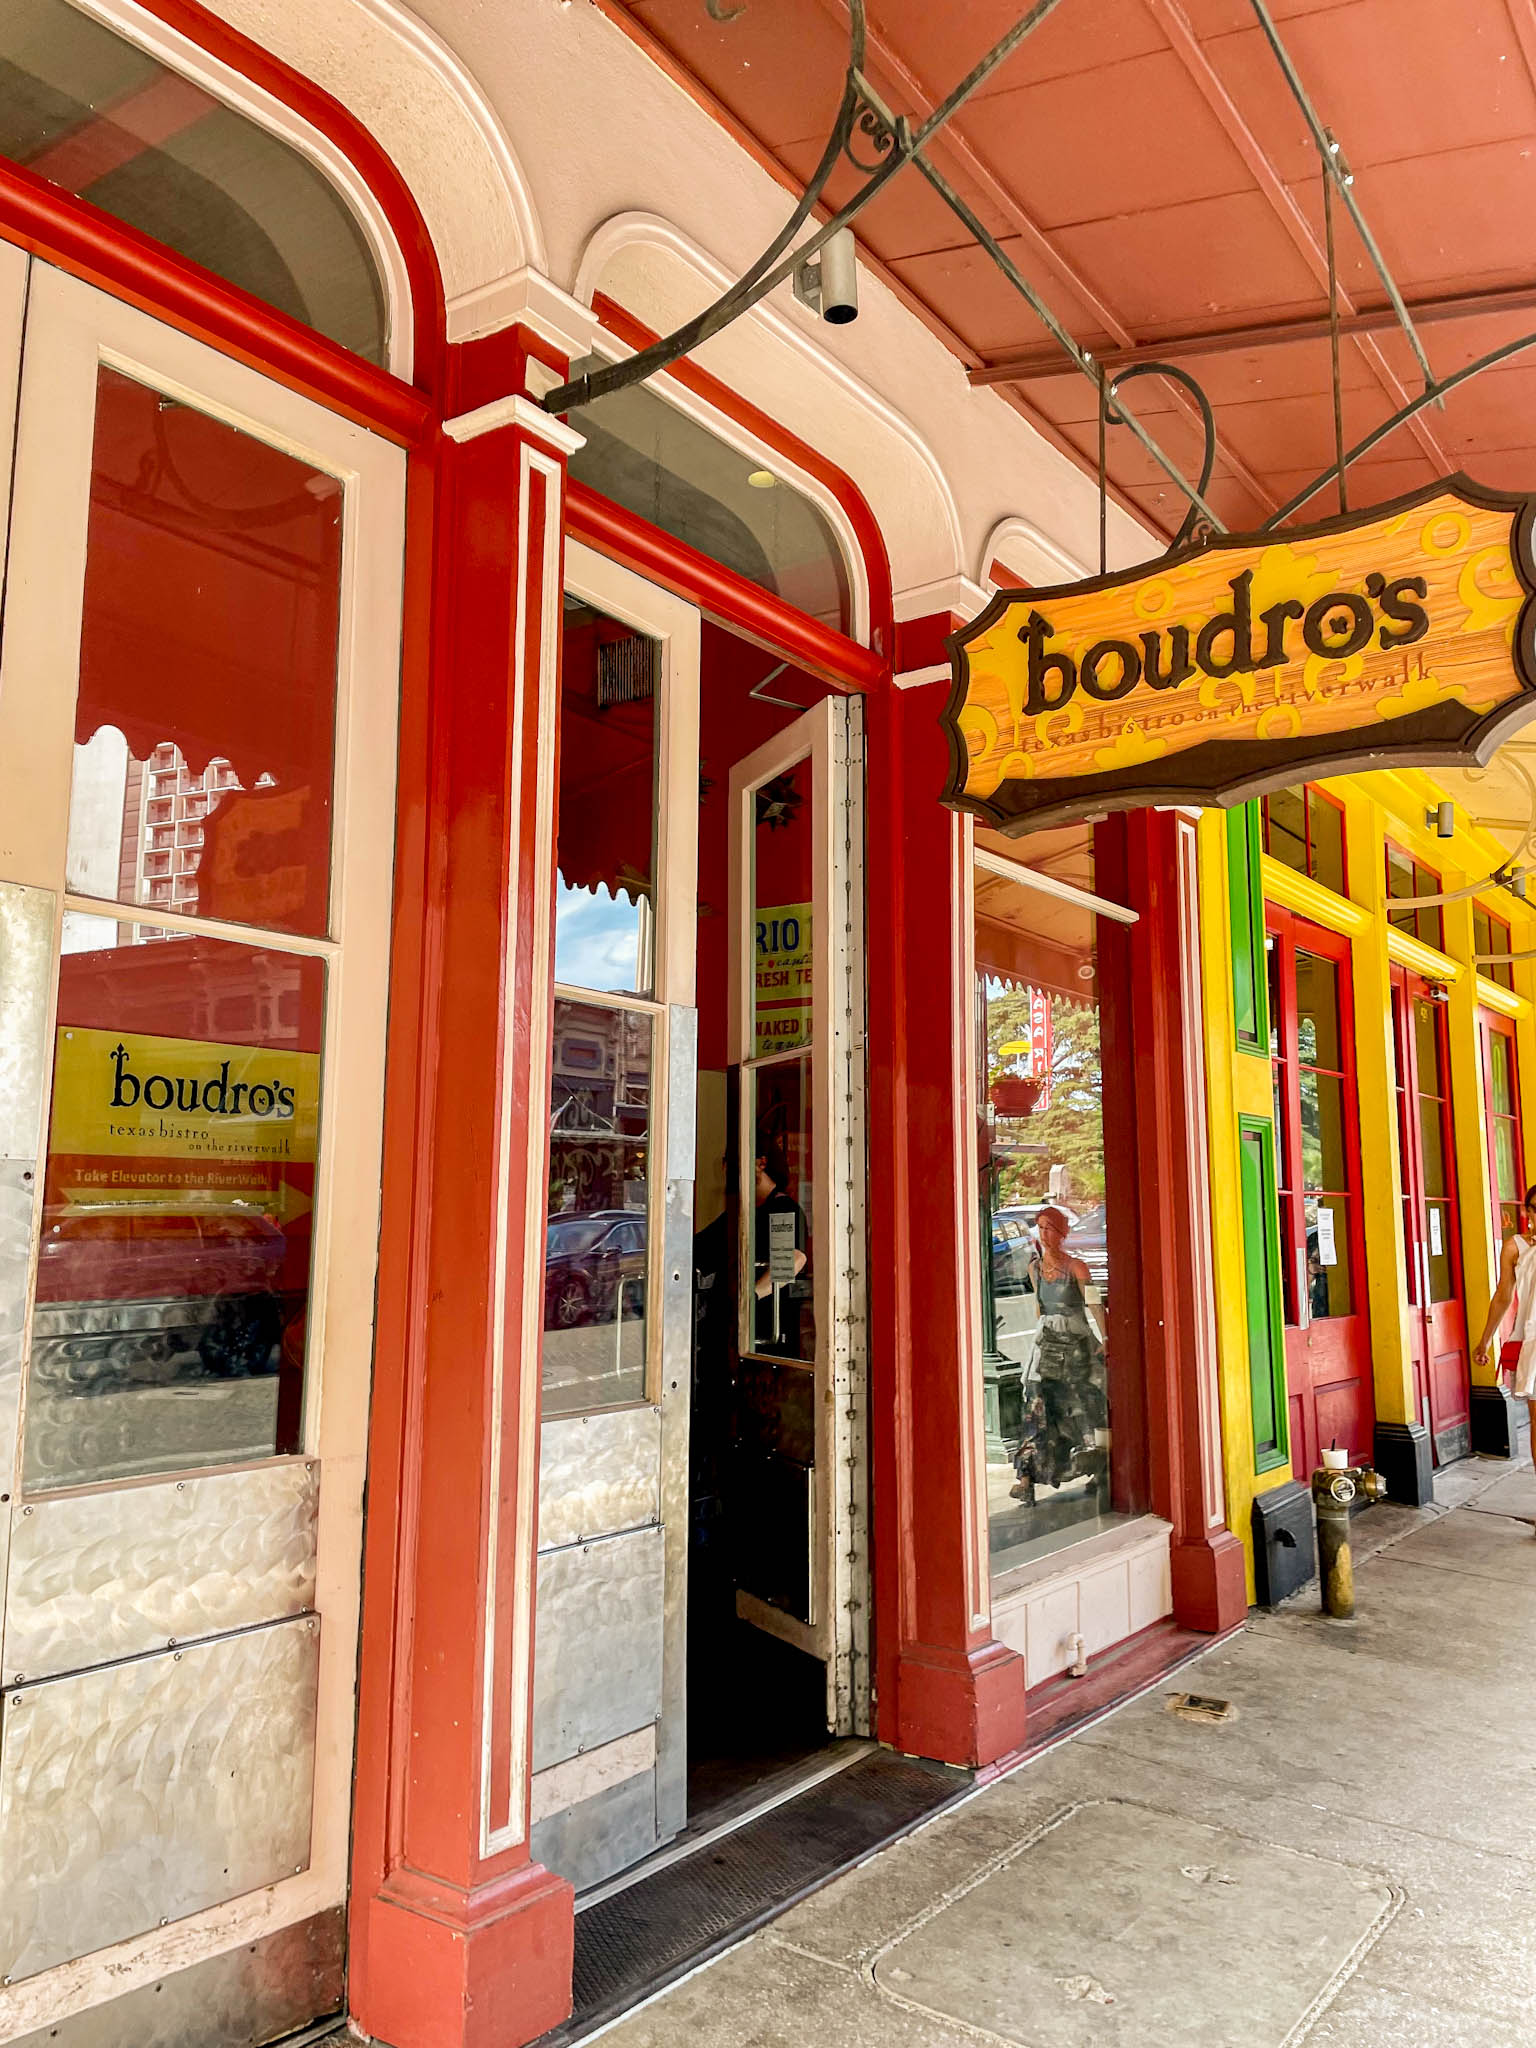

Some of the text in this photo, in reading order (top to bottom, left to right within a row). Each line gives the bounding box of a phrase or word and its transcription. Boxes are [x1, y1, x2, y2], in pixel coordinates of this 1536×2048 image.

[1017, 568, 1430, 716] boudro's
[1023, 651, 1431, 753] texas bistro on the riverwalk
[756, 968, 812, 988] RESH TE
[110, 1042, 294, 1118] boudro's
[109, 1118, 209, 1140] texas bistro
[188, 1138, 290, 1154] on the riverwalk
[75, 1168, 109, 1183] Take
[112, 1170, 166, 1184] Elevator
[168, 1172, 182, 1184] to
[185, 1171, 205, 1185] the
